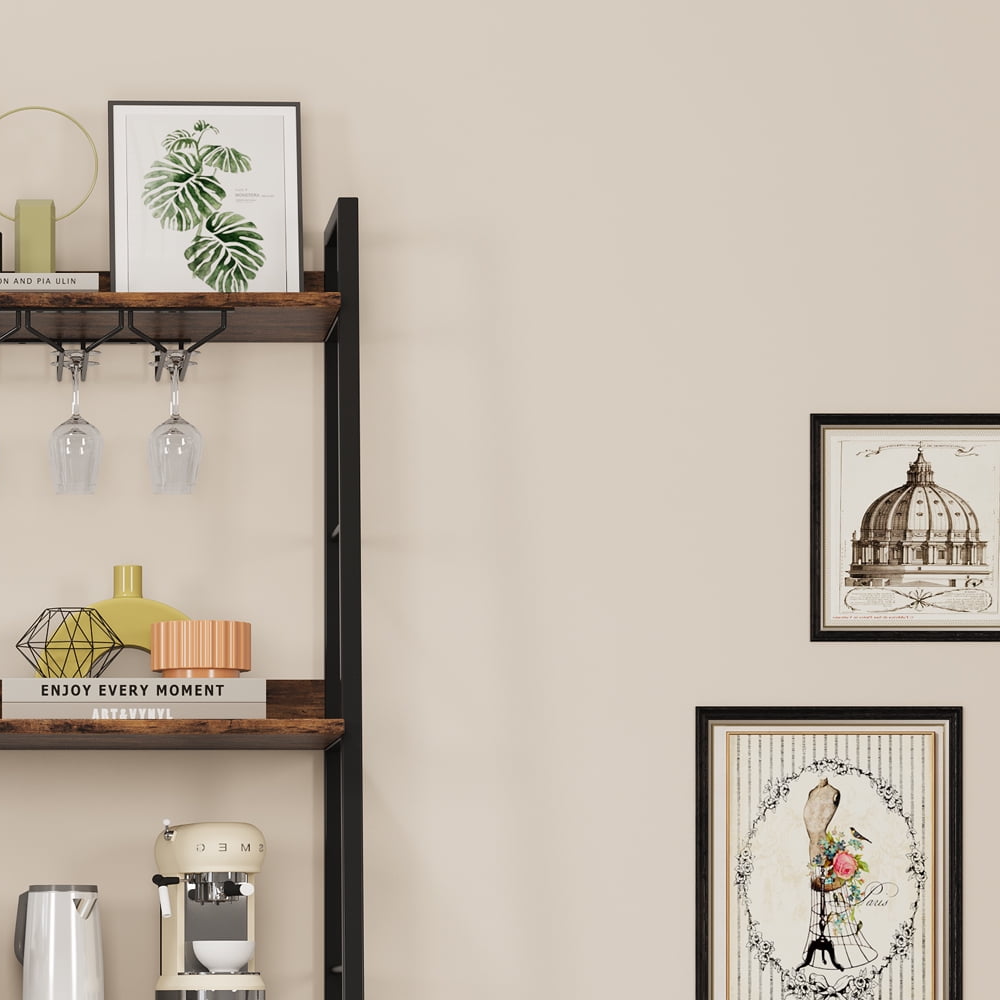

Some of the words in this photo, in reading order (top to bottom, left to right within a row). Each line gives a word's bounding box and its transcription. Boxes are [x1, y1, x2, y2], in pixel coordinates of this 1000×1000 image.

[13, 277, 33, 285] AND
[36, 277, 51, 285] PIA
[55, 277, 77, 285] ULIN
[41, 684, 92, 697] ENJOY
[98, 684, 149, 697] EVERY
[156, 684, 225, 697] MOMENT
[854, 881, 899, 907] Paris
